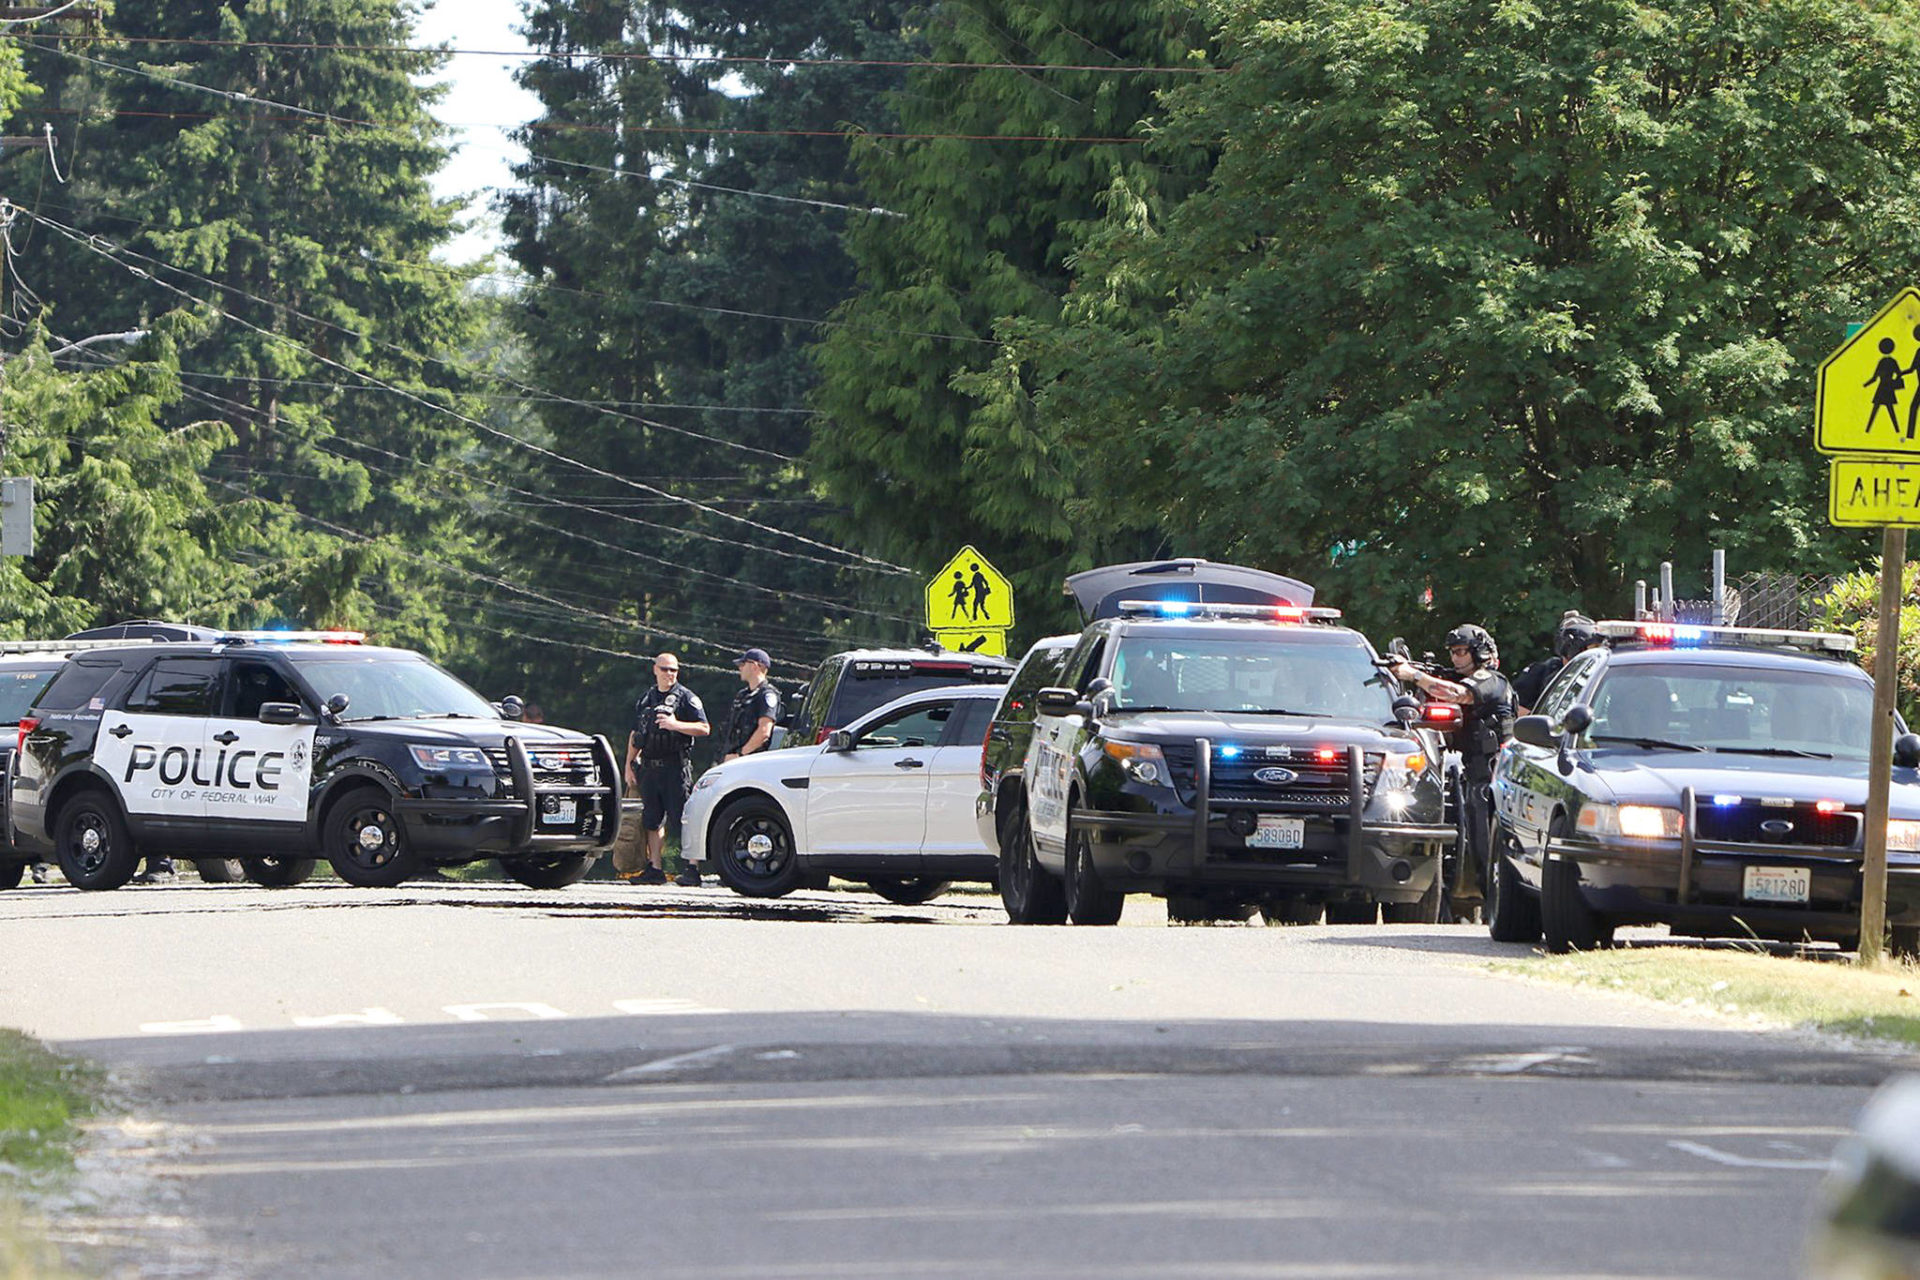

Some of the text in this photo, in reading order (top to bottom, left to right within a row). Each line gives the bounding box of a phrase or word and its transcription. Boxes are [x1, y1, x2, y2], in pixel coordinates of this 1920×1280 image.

[1849, 476, 1920, 508] AHE
[124, 745, 284, 790] POLICE
[1263, 770, 1287, 781] Ford
[151, 788, 278, 804] CITY OF FEDERAL WAY
